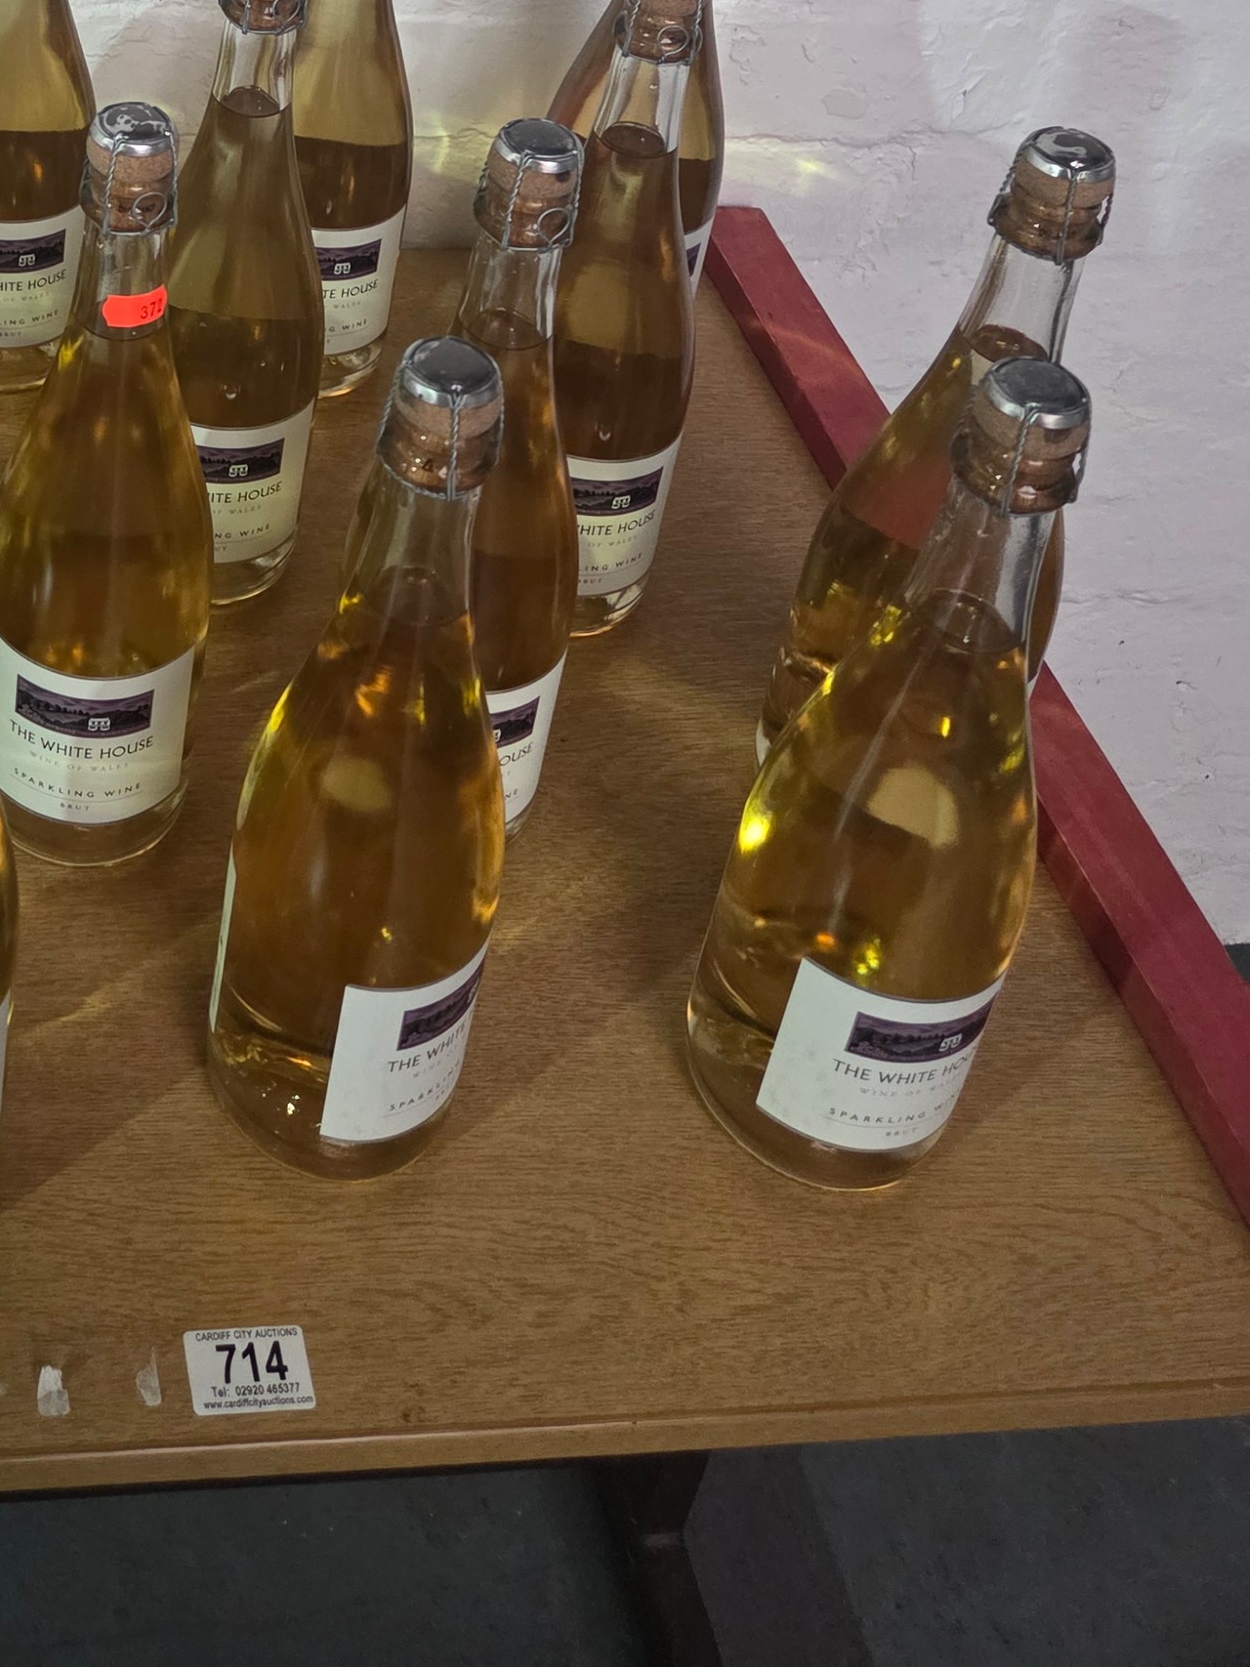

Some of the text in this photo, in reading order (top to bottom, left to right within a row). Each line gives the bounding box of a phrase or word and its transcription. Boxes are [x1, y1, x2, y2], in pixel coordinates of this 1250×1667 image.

[28, 269, 67, 290] HOUSE
[341, 278, 380, 298] HOUSE
[32, 309, 59, 323] WINE
[208, 481, 283, 504] ITE HOUSE
[240, 524, 271, 537] WINE
[578, 509, 658, 536] HITE HOUSE
[615, 552, 644, 568] WINE
[9, 718, 154, 760] THE WHITE HOUSE
[499, 741, 534, 767] OUSE
[14, 767, 142, 798] SPARKLING WINE
[60, 802, 91, 812] BRUT
[388, 1054, 422, 1073] THE
[832, 1058, 872, 1081] THE
[878, 1068, 936, 1084] WHITE
[830, 1107, 926, 1124] SPARKLING
[195, 1327, 298, 1342] CARDIFF CITY AUCTIONS
[215, 1340, 289, 1384] 714
[211, 1382, 300, 1398] Tel: 02920 465377
